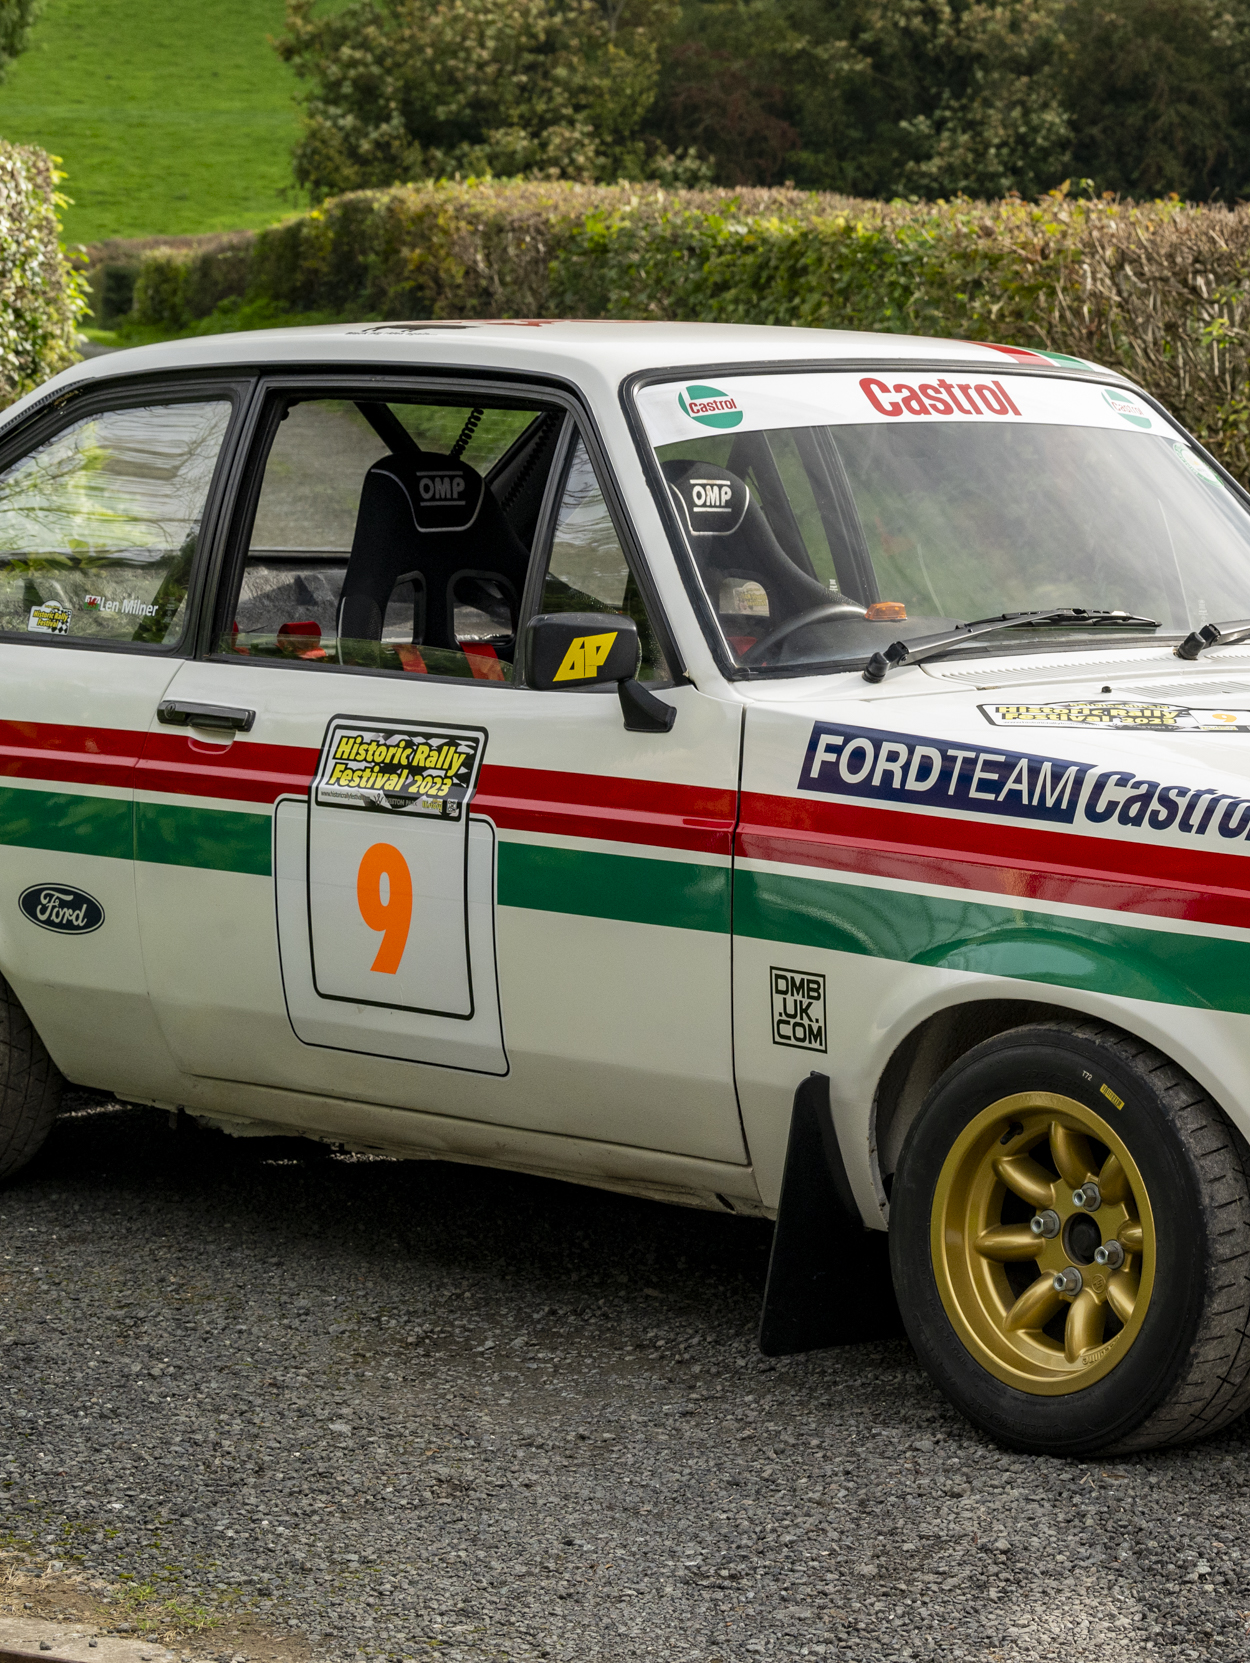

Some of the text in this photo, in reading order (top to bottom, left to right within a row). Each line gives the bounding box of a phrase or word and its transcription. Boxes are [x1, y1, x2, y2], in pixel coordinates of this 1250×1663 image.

[688, 398, 738, 414] Castrol
[859, 377, 1022, 417] Castrol
[419, 477, 465, 499] OMP
[692, 485, 732, 506] OMP
[100, 597, 119, 612] Len
[121, 599, 159, 617] Milner
[998, 705, 1180, 719] Historic Rally
[1004, 713, 1110, 722] Festival
[1212, 713, 1238, 723] 9
[334, 736, 467, 777] Historic Rally
[328, 764, 453, 797] Festival 2023
[36, 889, 88, 928] Ford
[356, 842, 413, 975] 9
[774, 973, 822, 1002] DMB
[776, 1018, 823, 1047] COM
